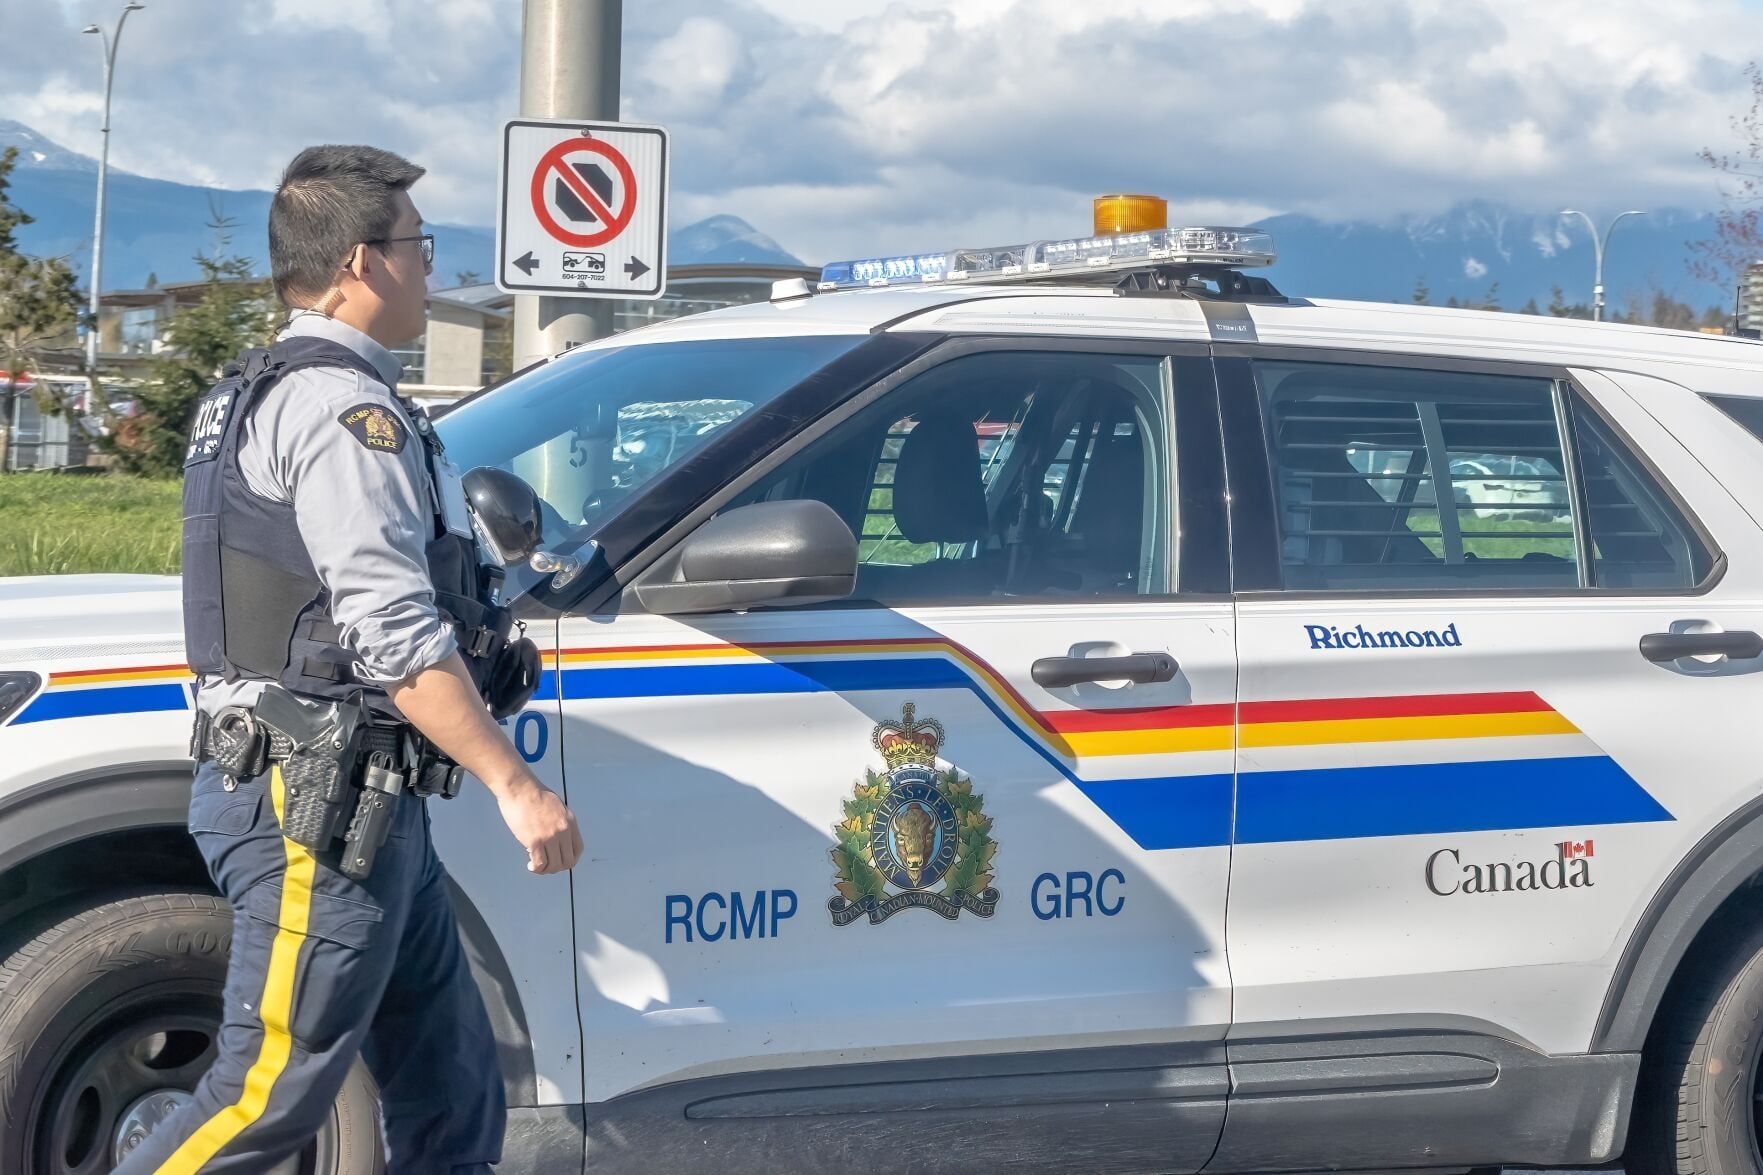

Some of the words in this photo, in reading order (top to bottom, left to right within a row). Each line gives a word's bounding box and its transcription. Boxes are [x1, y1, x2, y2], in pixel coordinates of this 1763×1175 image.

[562, 273, 605, 281] 604-207-7022
[345, 409, 370, 425] RCMP
[367, 438, 398, 449] POLICE
[1303, 622, 1463, 650] Richmond
[873, 785, 914, 879] MAINTIENS
[931, 817, 956, 875] DROIT
[1425, 842, 1595, 896] Canada
[918, 895, 960, 917] MOUNTED
[963, 895, 995, 916] POLICE
[1031, 868, 1126, 921] GRC
[665, 889, 798, 944] RCMP
